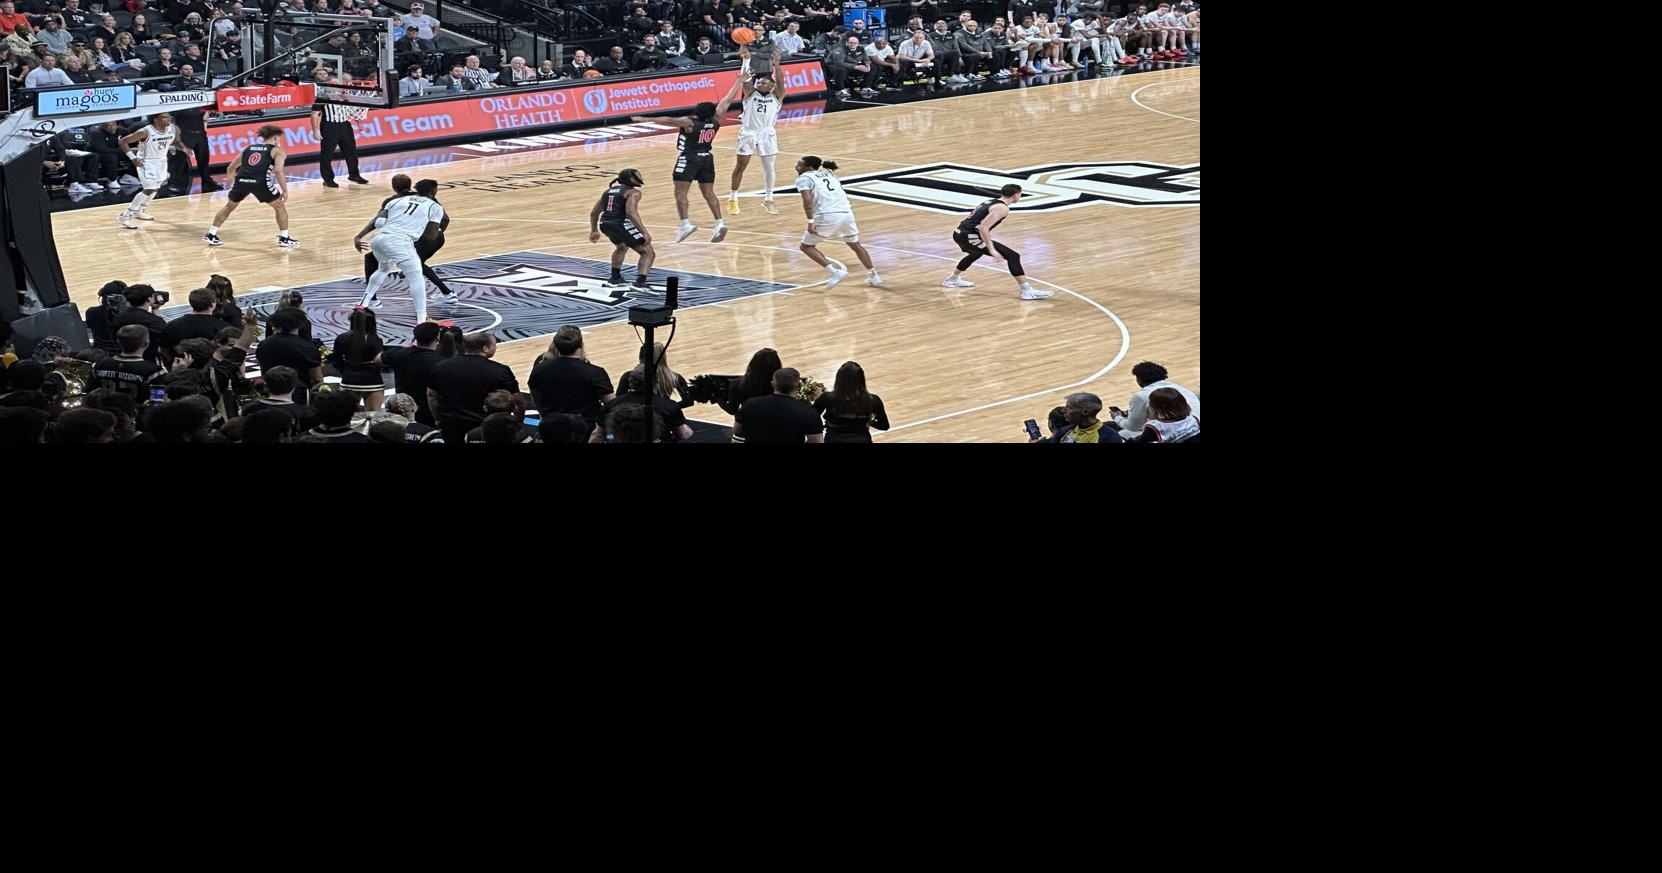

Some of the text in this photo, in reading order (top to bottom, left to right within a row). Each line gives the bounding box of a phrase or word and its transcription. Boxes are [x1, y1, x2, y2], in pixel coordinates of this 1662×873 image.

[608, 77, 715, 99] Jewett Orthopedic
[56, 93, 119, 111] magoos
[159, 91, 203, 104] SPALDING
[480, 92, 567, 114] ORLANDO
[611, 99, 660, 111] Institute
[757, 104, 767, 113] 21
[385, 112, 454, 135] Team
[495, 110, 561, 130] HEALTH
[699, 129, 715, 143] 10
[157, 141, 168, 150] 24
[248, 152, 262, 166] 0
[823, 178, 835, 192] 2
